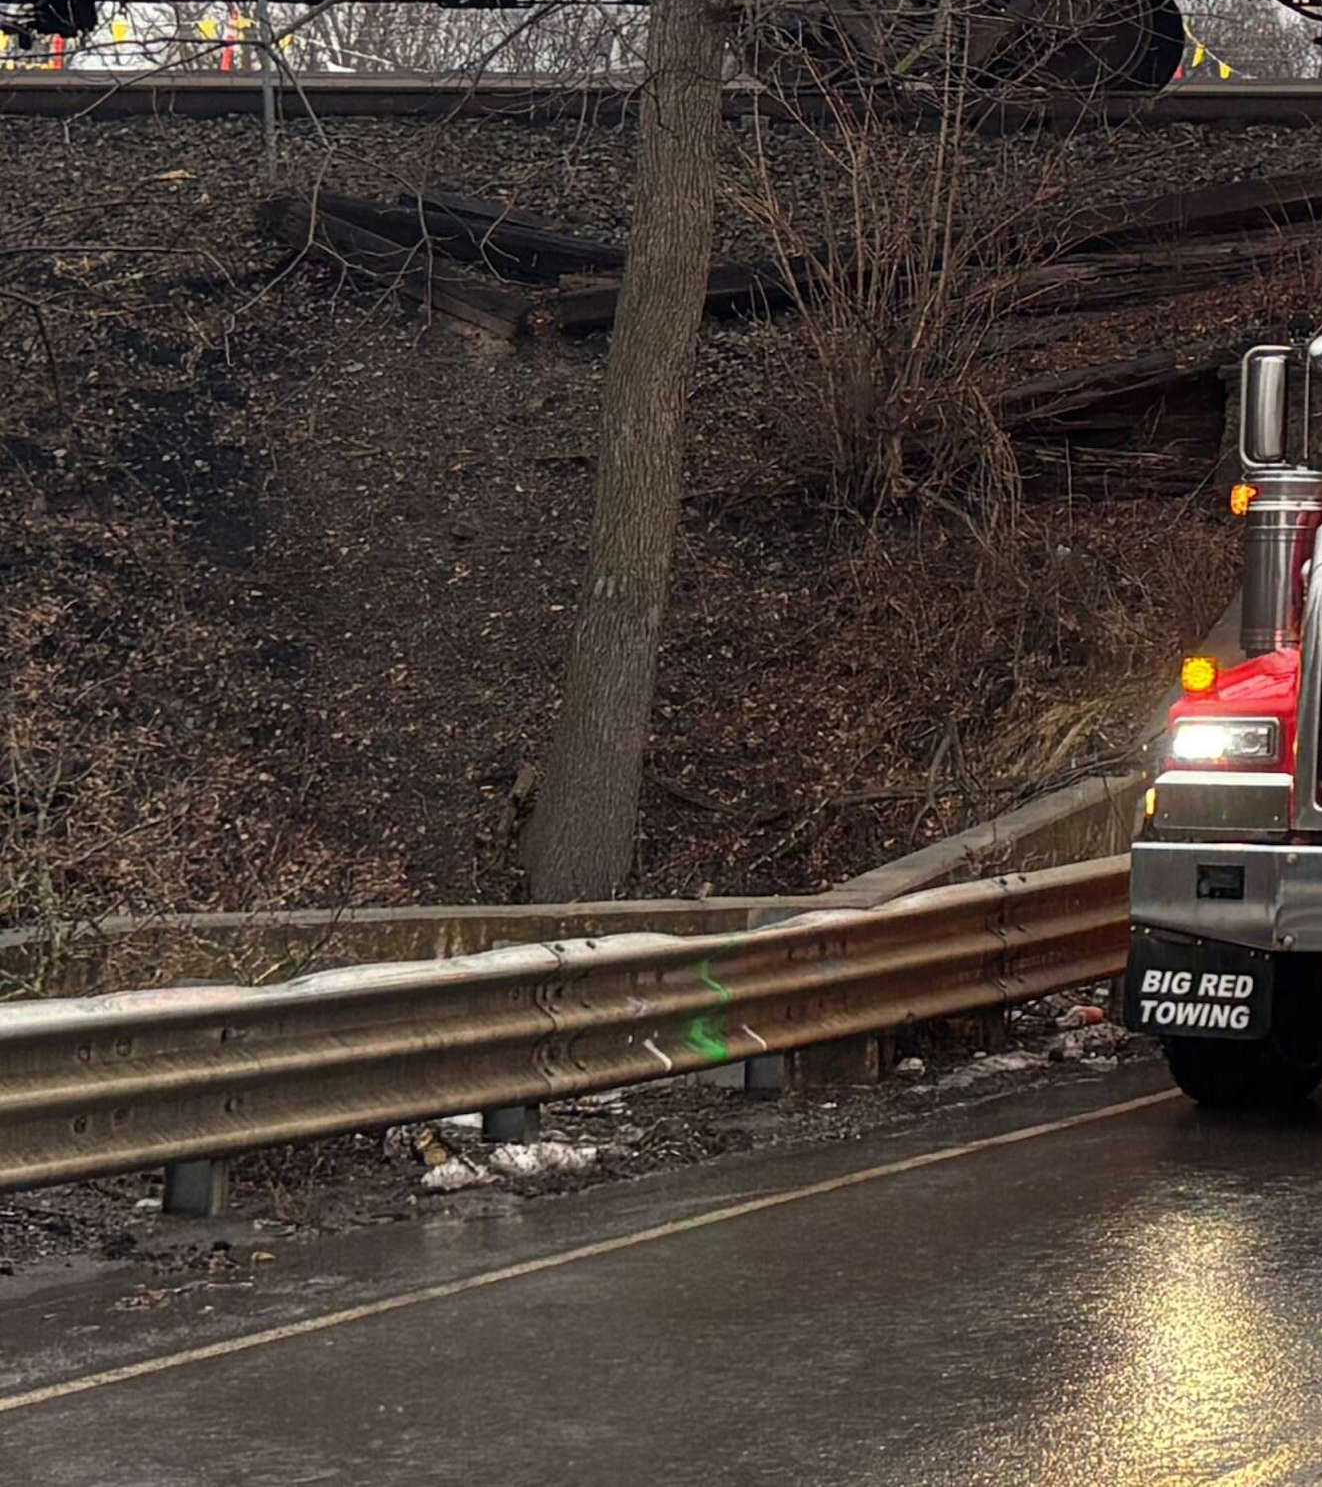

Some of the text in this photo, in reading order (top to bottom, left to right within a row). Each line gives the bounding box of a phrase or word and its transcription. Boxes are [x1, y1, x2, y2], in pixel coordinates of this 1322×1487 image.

[1141, 969, 1254, 998] BIG RED
[1140, 999, 1251, 1030] TOWING
